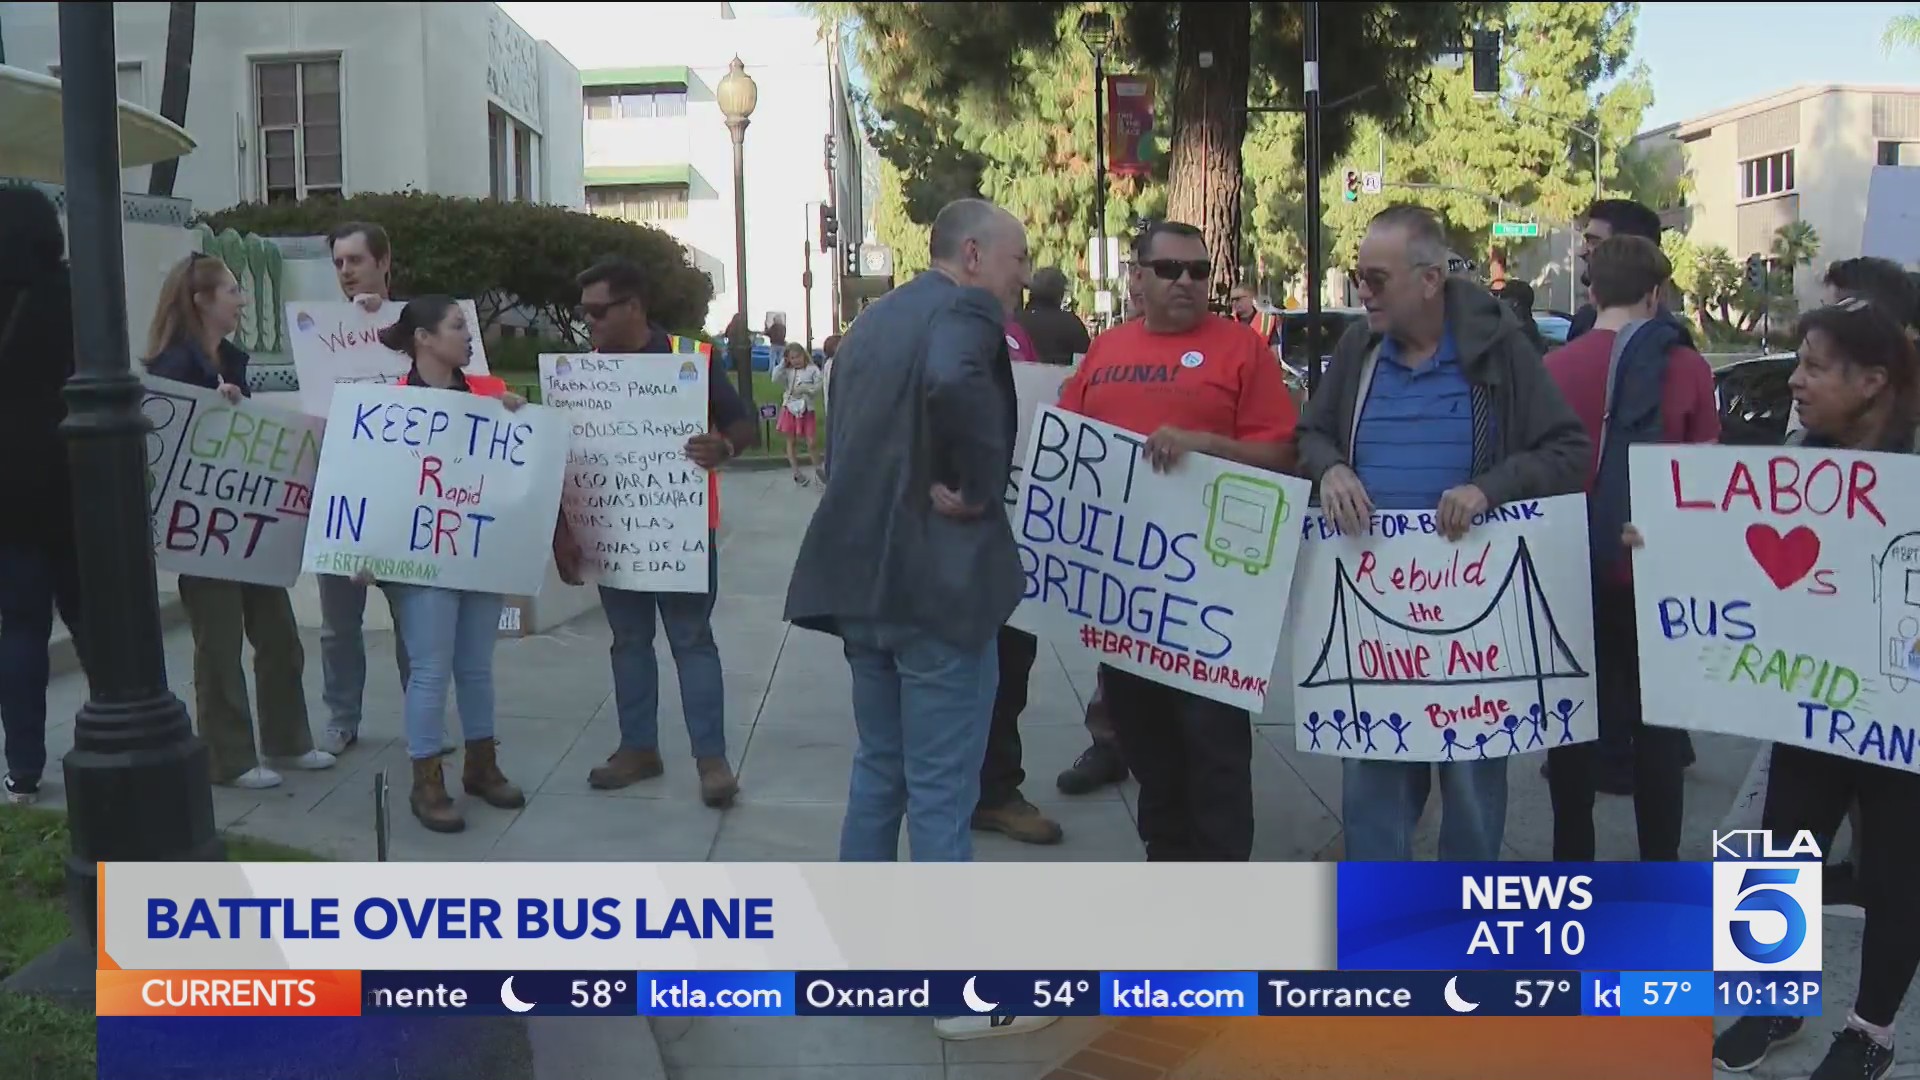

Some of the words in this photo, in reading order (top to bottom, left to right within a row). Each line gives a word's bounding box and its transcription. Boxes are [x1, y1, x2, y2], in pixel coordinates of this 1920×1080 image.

[580, 358, 624, 371] BRT
[190, 407, 319, 475] GREEN
[352, 403, 449, 448] KEEP
[464, 412, 534, 467] THE
[573, 421, 638, 438] OBUSES
[1030, 411, 1144, 503] BRT
[180, 458, 279, 508] LIGHT
[615, 471, 662, 489] PARA
[669, 469, 704, 484] LAS
[1671, 456, 1887, 527] LABOR
[166, 500, 279, 559] BRT
[326, 496, 367, 542] IN
[410, 505, 496, 558] BRT
[595, 541, 641, 555] ONAS
[649, 541, 672, 553] DE
[682, 540, 705, 552] LA
[1022, 484, 1199, 583] BUILDS
[633, 560, 687, 572] EDAD
[1355, 540, 1492, 594] Rebuild
[1014, 544, 1234, 660] BRIDGES
[1407, 600, 1445, 623] the
[1658, 597, 1757, 641] BUS
[1079, 624, 1268, 696] #BRTFORBURBANK
[1357, 639, 1432, 681] Olive
[1447, 639, 1500, 677] Ave
[1728, 643, 1860, 709] RAPID
[1424, 694, 1511, 730] Bridge
[1797, 701, 1920, 767] TRAN
